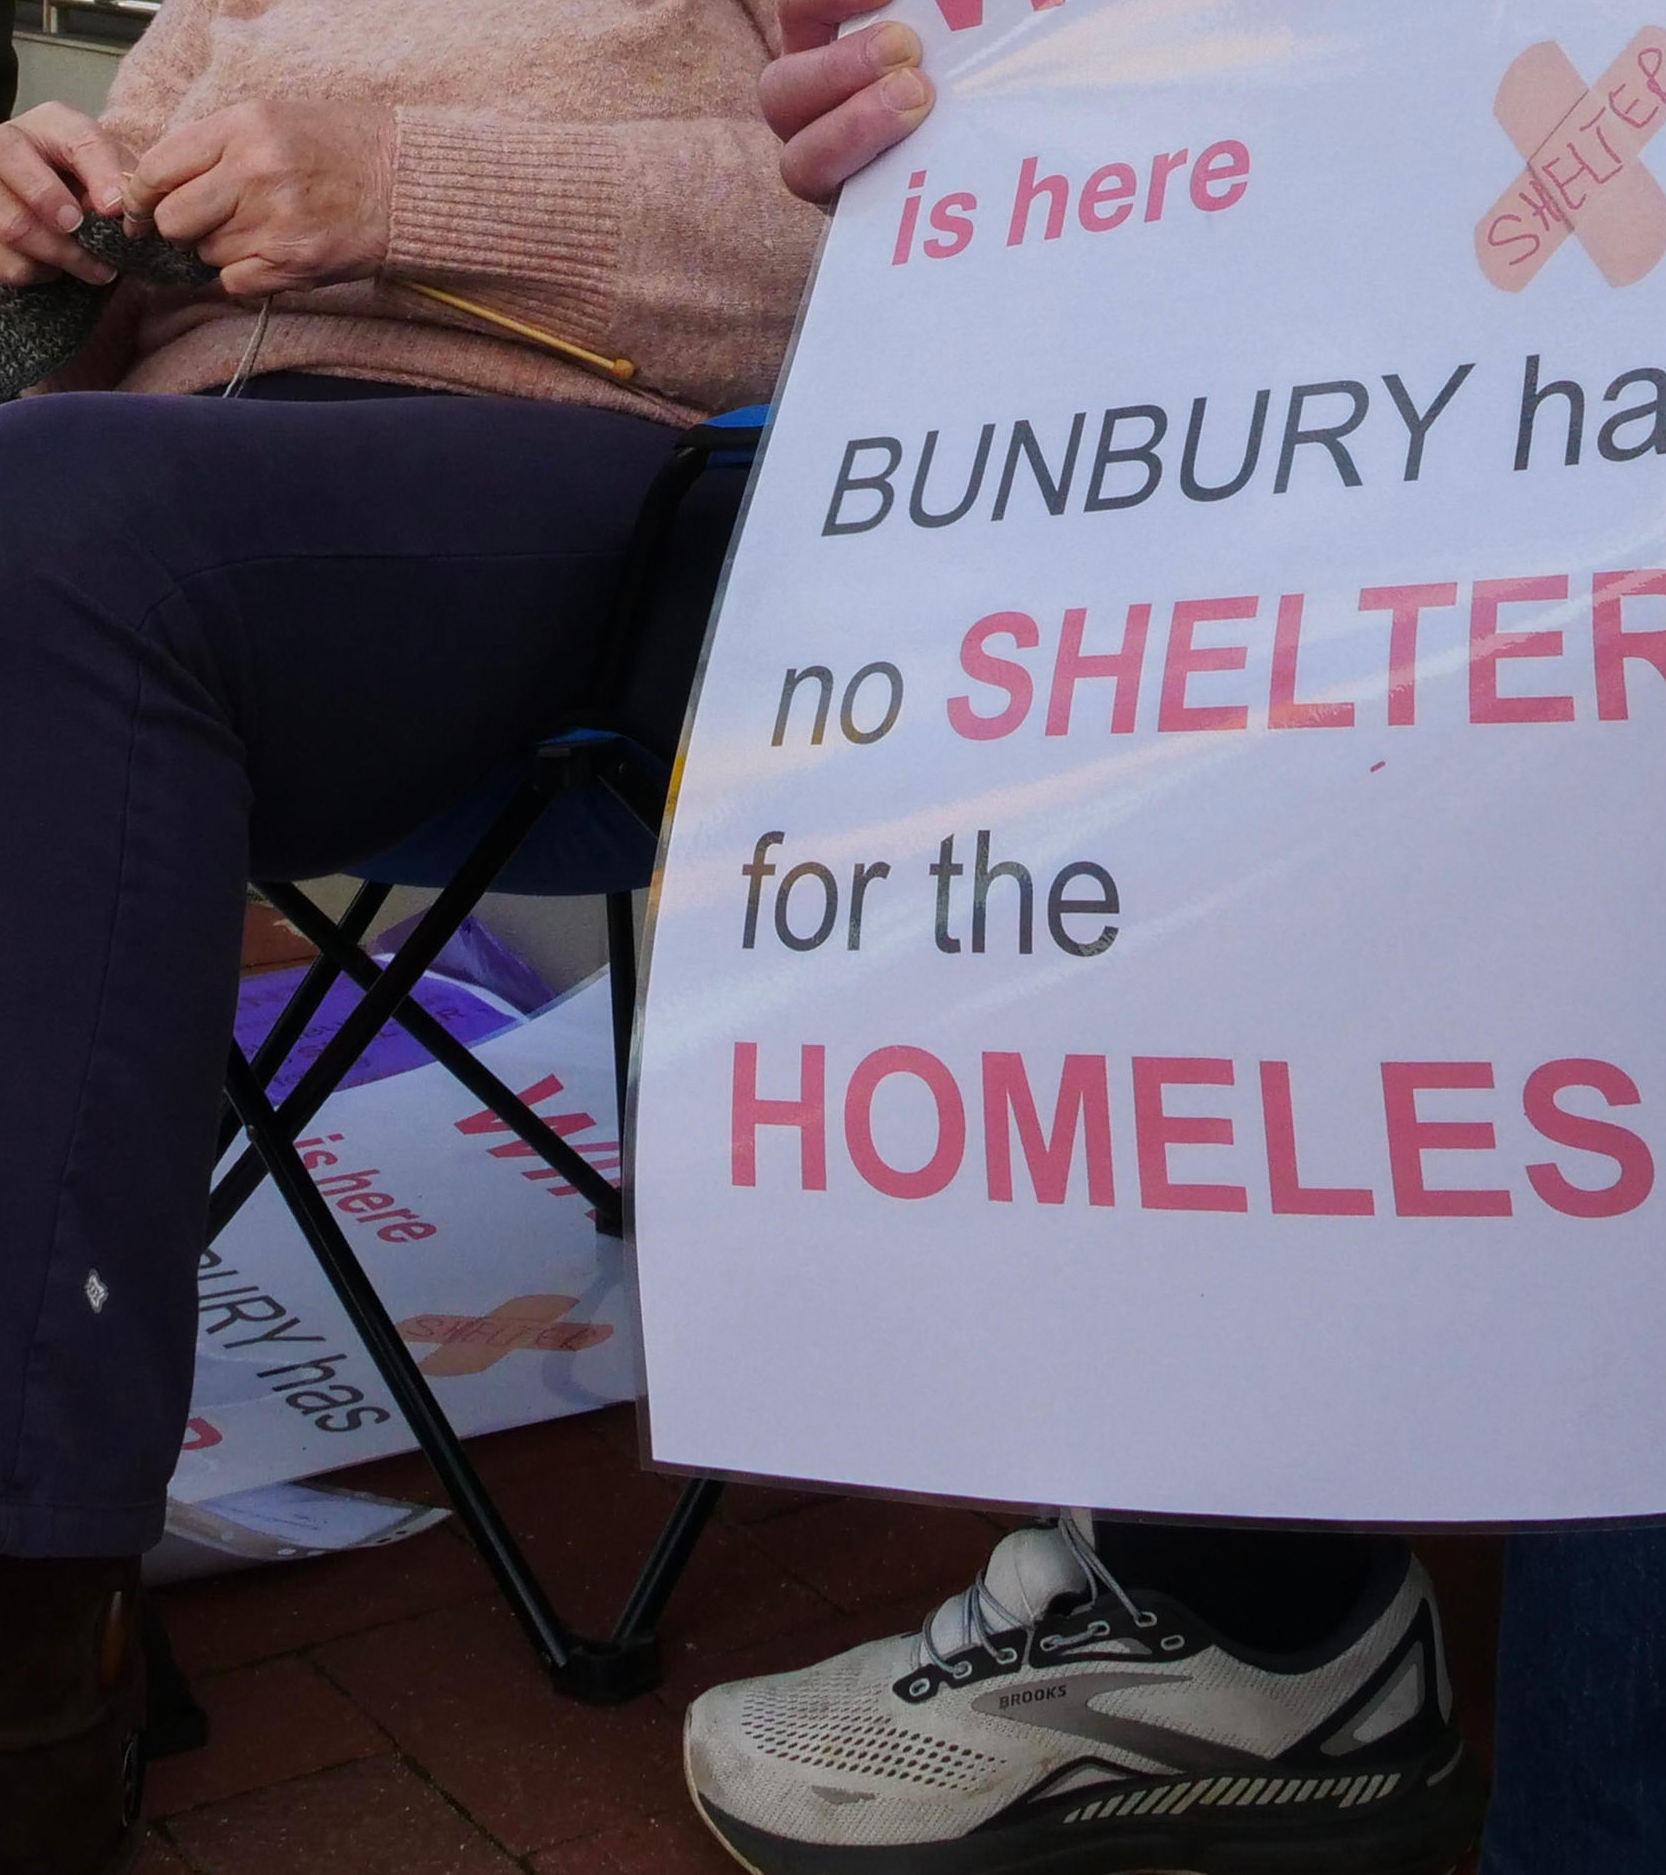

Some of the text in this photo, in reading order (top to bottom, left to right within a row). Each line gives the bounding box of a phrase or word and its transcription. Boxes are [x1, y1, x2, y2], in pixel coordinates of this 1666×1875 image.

[891, 139, 1251, 265] is here
[821, 364, 1476, 536] BUNBURY
[771, 658, 904, 747] no
[740, 829, 1121, 957] for the
[315, 1168, 437, 1243] here
[256, 1353, 391, 1433] has
[999, 1685, 1067, 1710] BROOKS
